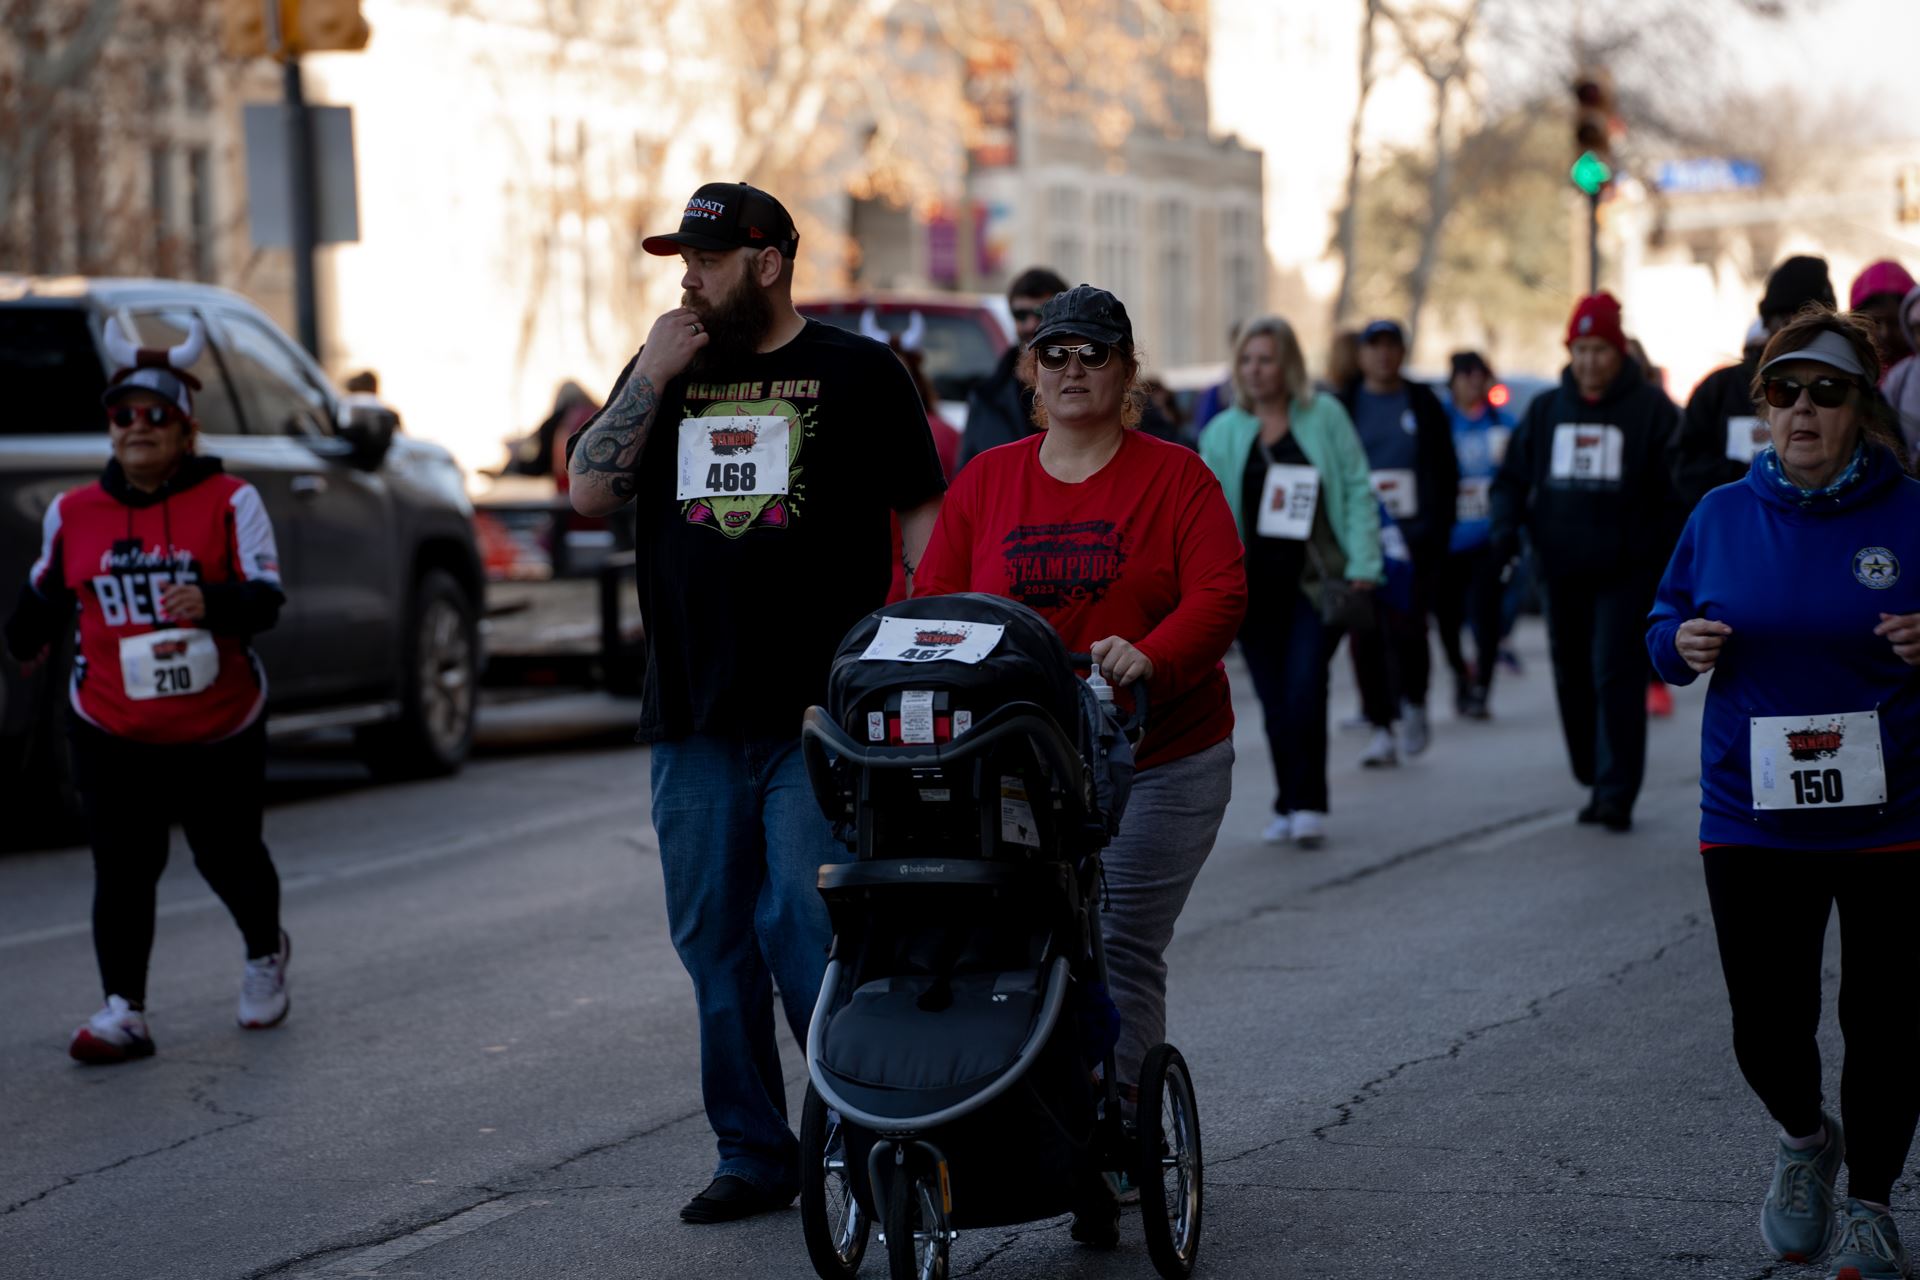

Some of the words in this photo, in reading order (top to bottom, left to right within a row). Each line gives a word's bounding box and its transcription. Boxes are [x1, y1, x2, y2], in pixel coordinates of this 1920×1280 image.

[686, 382, 763, 400] HUMANS
[770, 380, 820, 398] SUCK
[706, 462, 757, 492] 468
[1007, 554, 1118, 585] STAMPEDE
[1024, 585, 1055, 595] 2023
[898, 648, 955, 660] 467
[154, 666, 191, 694] 210
[1790, 768, 1844, 805] 150
